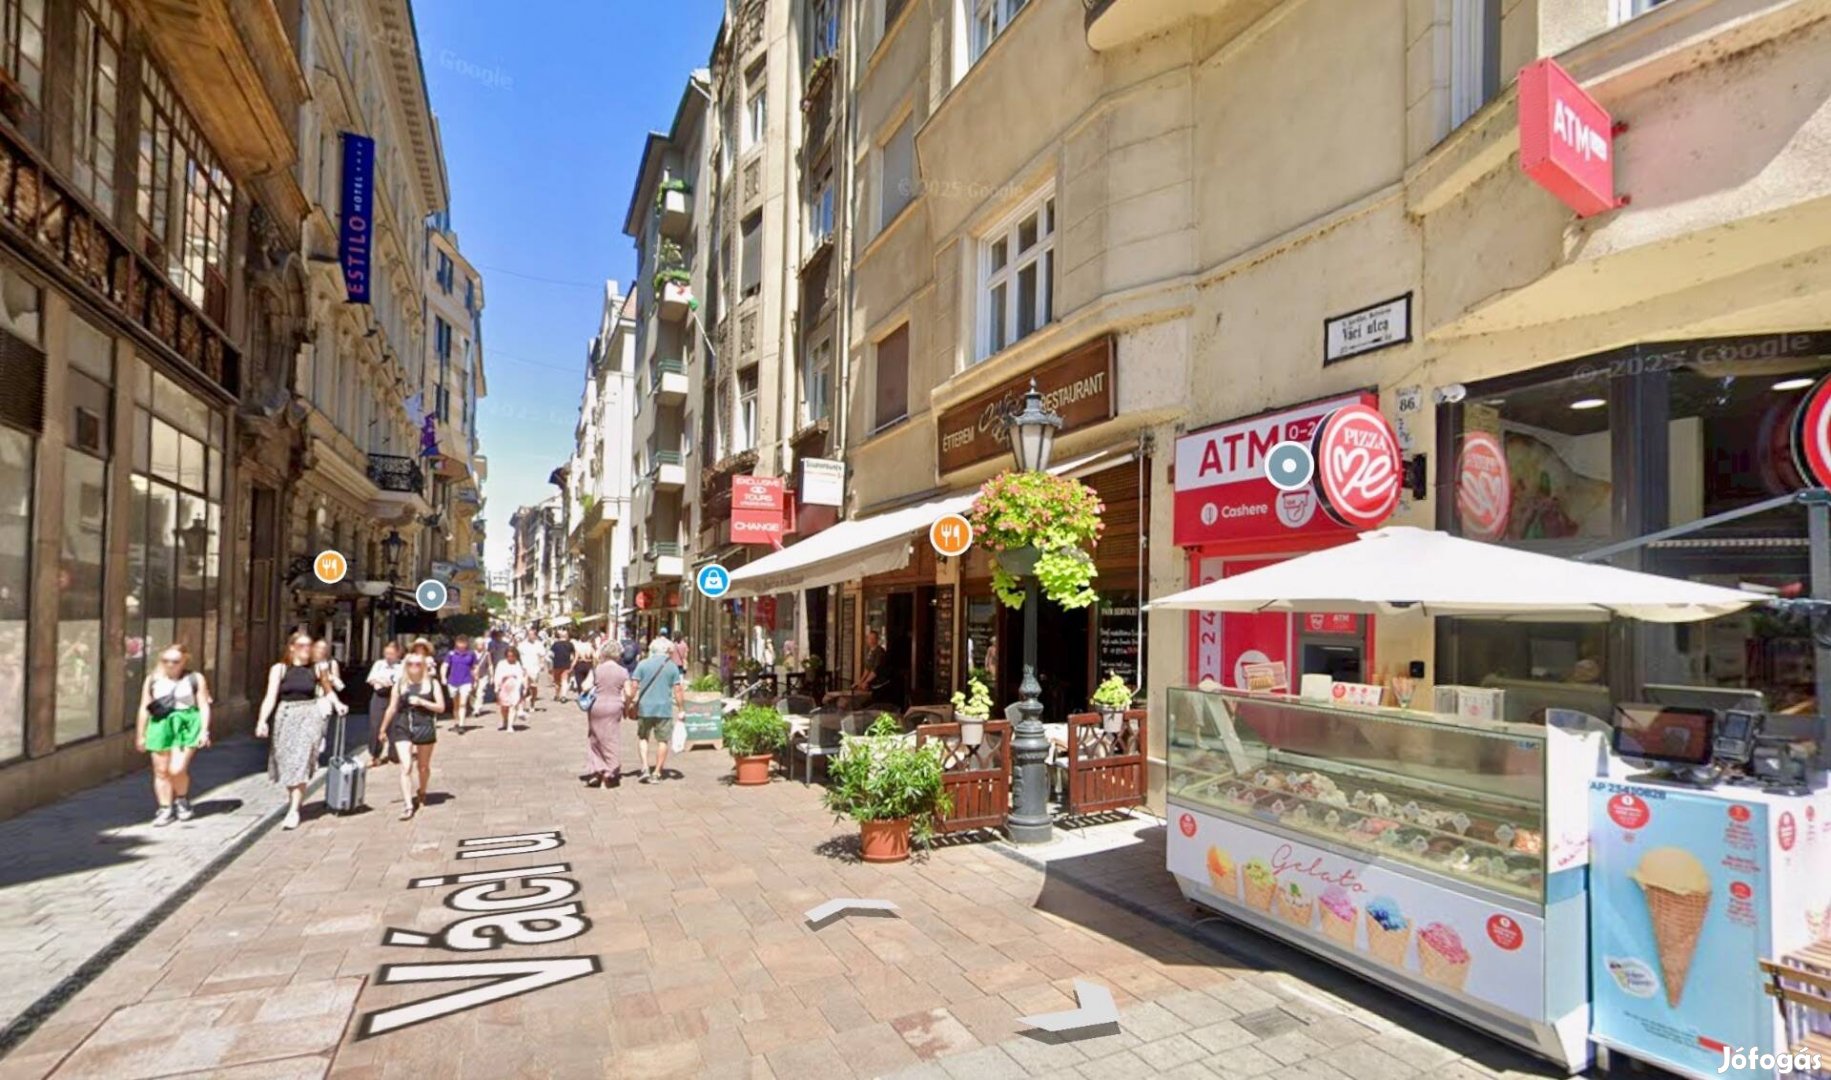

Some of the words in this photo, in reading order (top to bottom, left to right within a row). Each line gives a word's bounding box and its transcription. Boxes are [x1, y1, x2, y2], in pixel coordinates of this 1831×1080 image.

[1553, 98, 1591, 161] ATM
[353, 176, 363, 212] HOTEL
[347, 214, 366, 294] ESTILO
[1342, 323, 1362, 341] Váci
[943, 426, 975, 452] ÉTTEREM
[1041, 372, 1105, 413] RESTAURANT
[1198, 424, 1280, 478] ATM
[1343, 427, 1388, 449] PIZZA
[736, 477, 781, 487] EXCLUSIVE
[744, 493, 774, 502] TOURS
[1220, 501, 1269, 519] Cashere
[734, 521, 780, 532] CHANGE
[1271, 843, 1367, 894] Gelato
